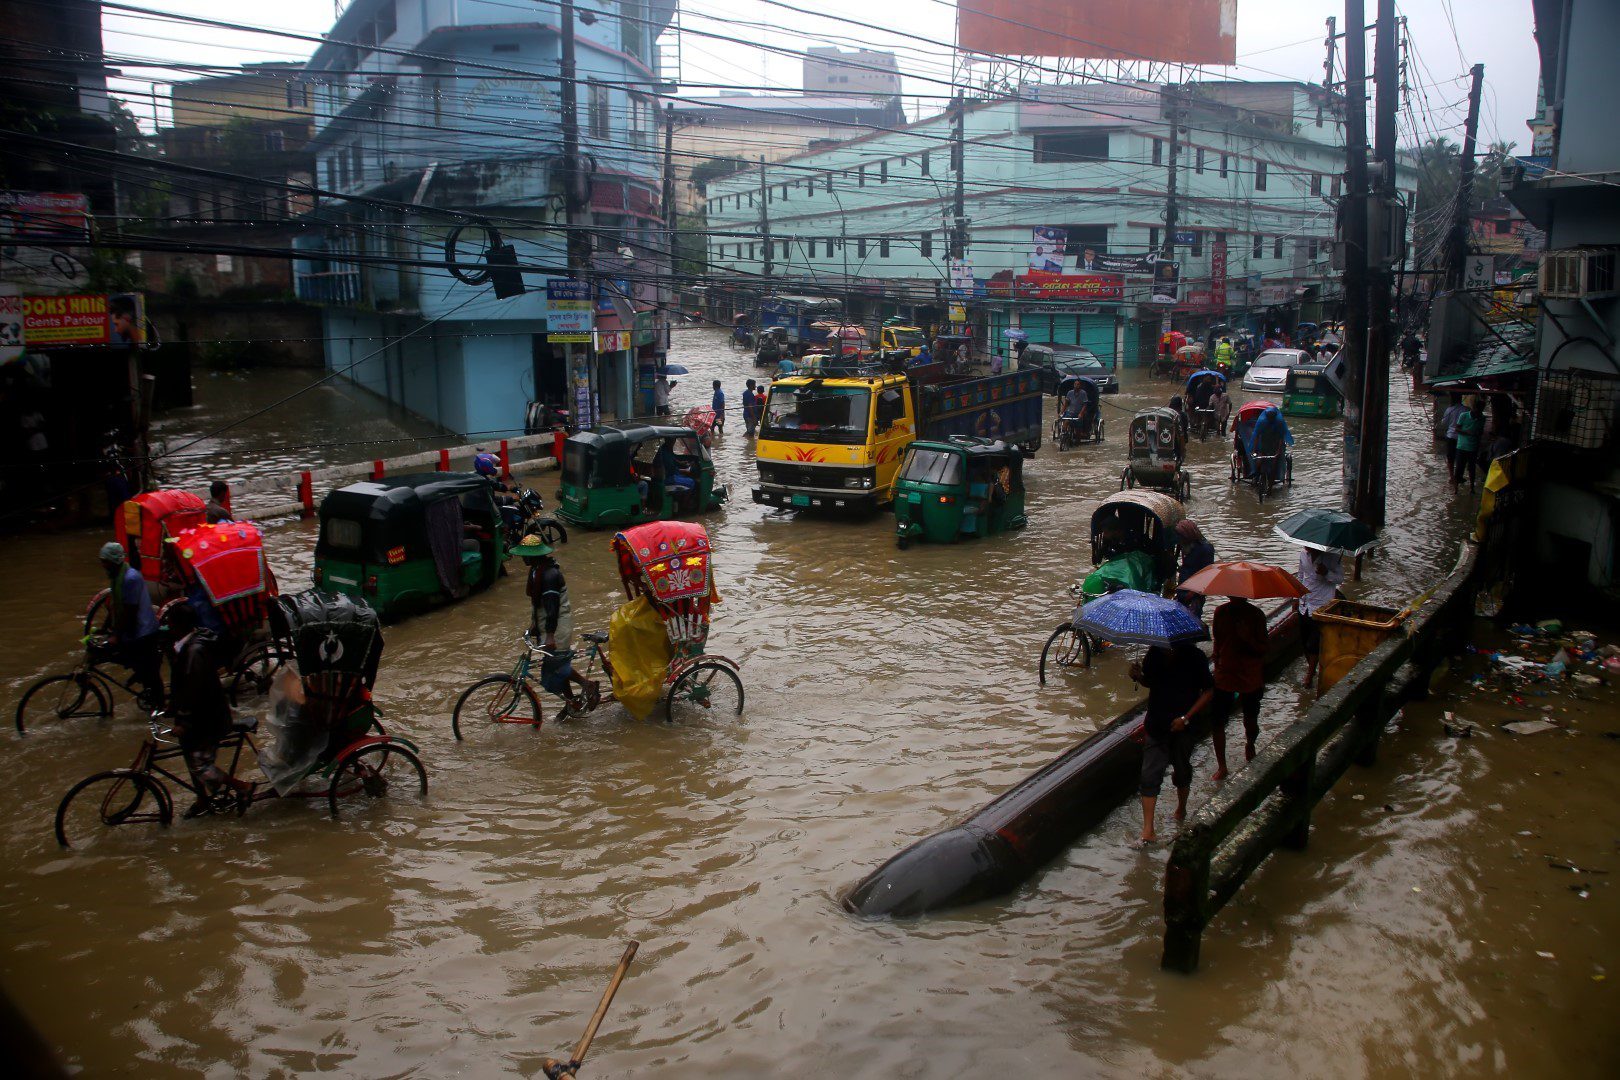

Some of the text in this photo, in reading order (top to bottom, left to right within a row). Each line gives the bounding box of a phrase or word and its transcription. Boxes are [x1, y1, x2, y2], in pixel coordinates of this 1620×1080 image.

[69, 297, 107, 314] HAIR
[26, 315, 106, 327] Gents Parlour
